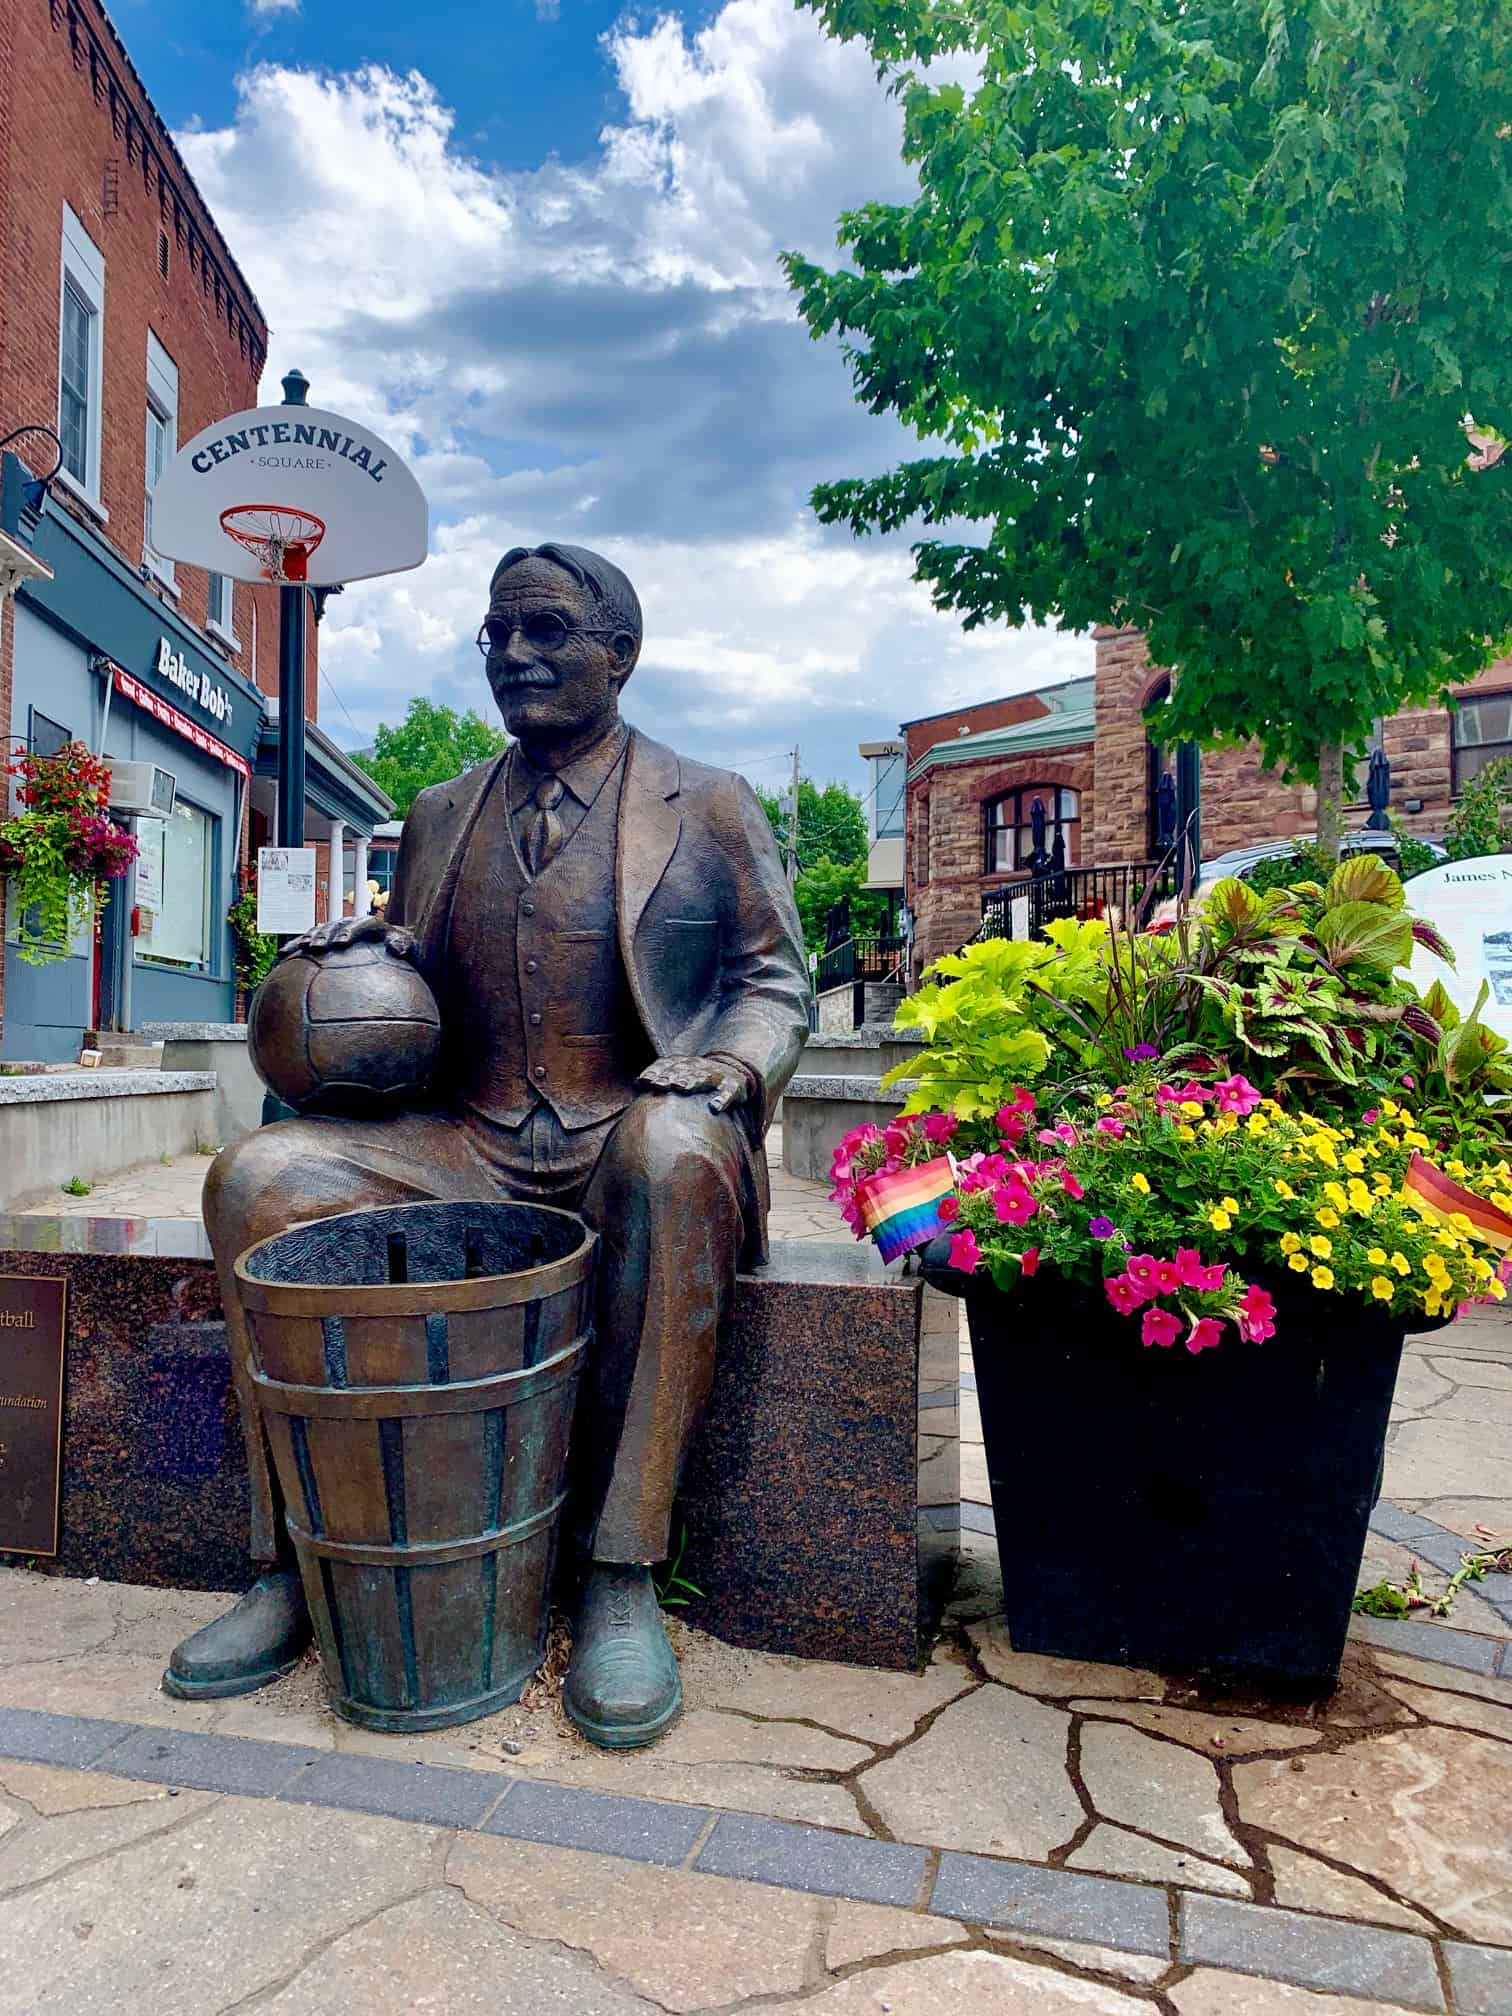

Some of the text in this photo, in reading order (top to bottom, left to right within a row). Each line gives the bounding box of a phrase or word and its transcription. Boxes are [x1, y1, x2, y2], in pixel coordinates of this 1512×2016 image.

[191, 422, 388, 483] CENTENNIAL
[258, 456, 325, 470] SQUARE
[158, 636, 200, 700] Baker
[200, 672, 232, 727] Bob's
[1443, 873, 1497, 883] James
